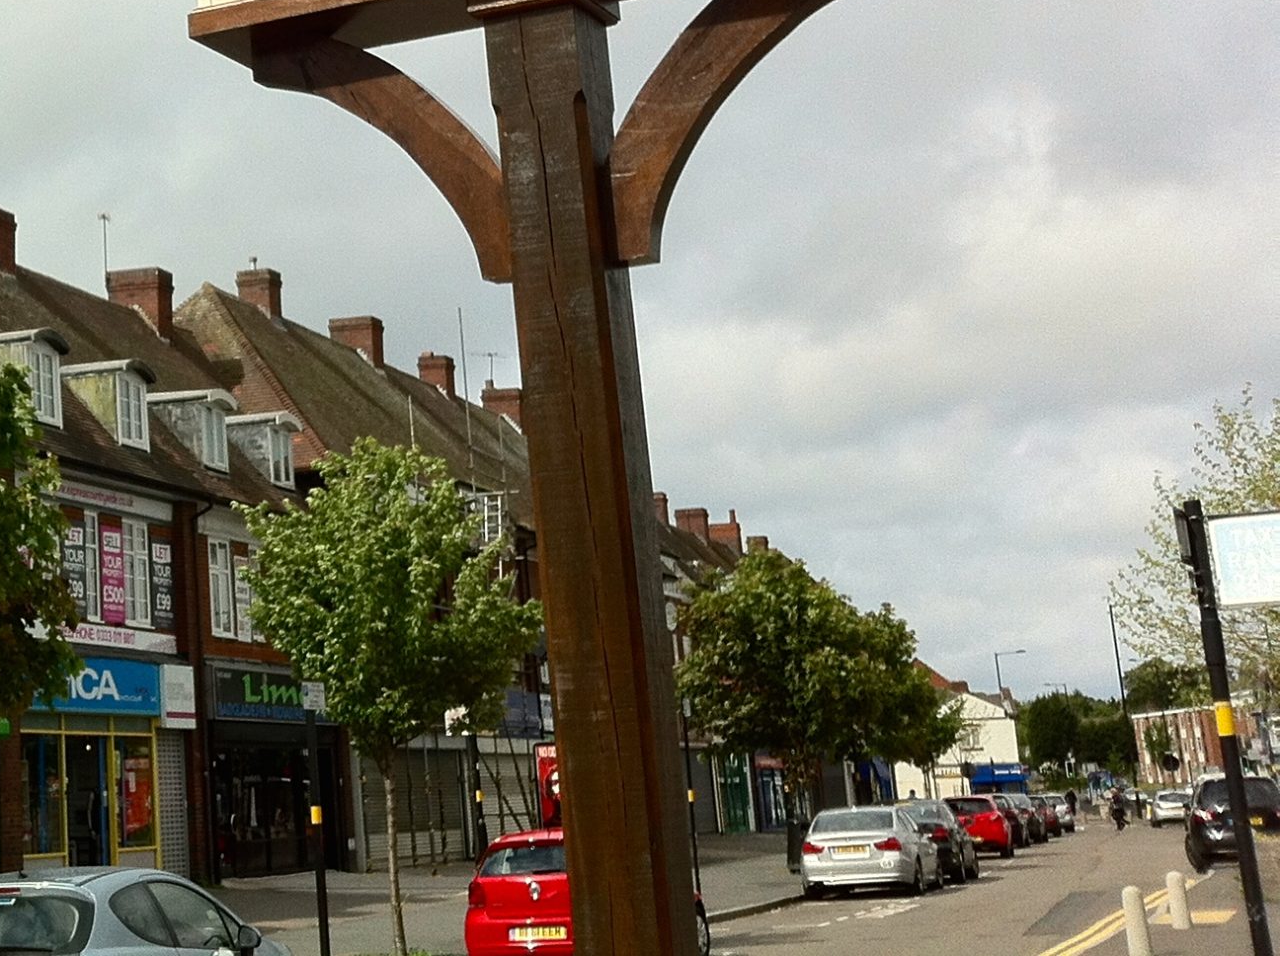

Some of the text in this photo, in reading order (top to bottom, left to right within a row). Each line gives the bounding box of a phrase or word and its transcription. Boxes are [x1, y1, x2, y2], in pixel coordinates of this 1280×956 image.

[104, 534, 120, 549] SELL
[64, 548, 84, 563] YOUR
[154, 545, 169, 560] LET
[103, 555, 122, 569] YOUR
[153, 564, 171, 577] YOUR
[103, 585, 124, 603] £500
[156, 593, 172, 611] £99
[242, 673, 304, 704] Lim
